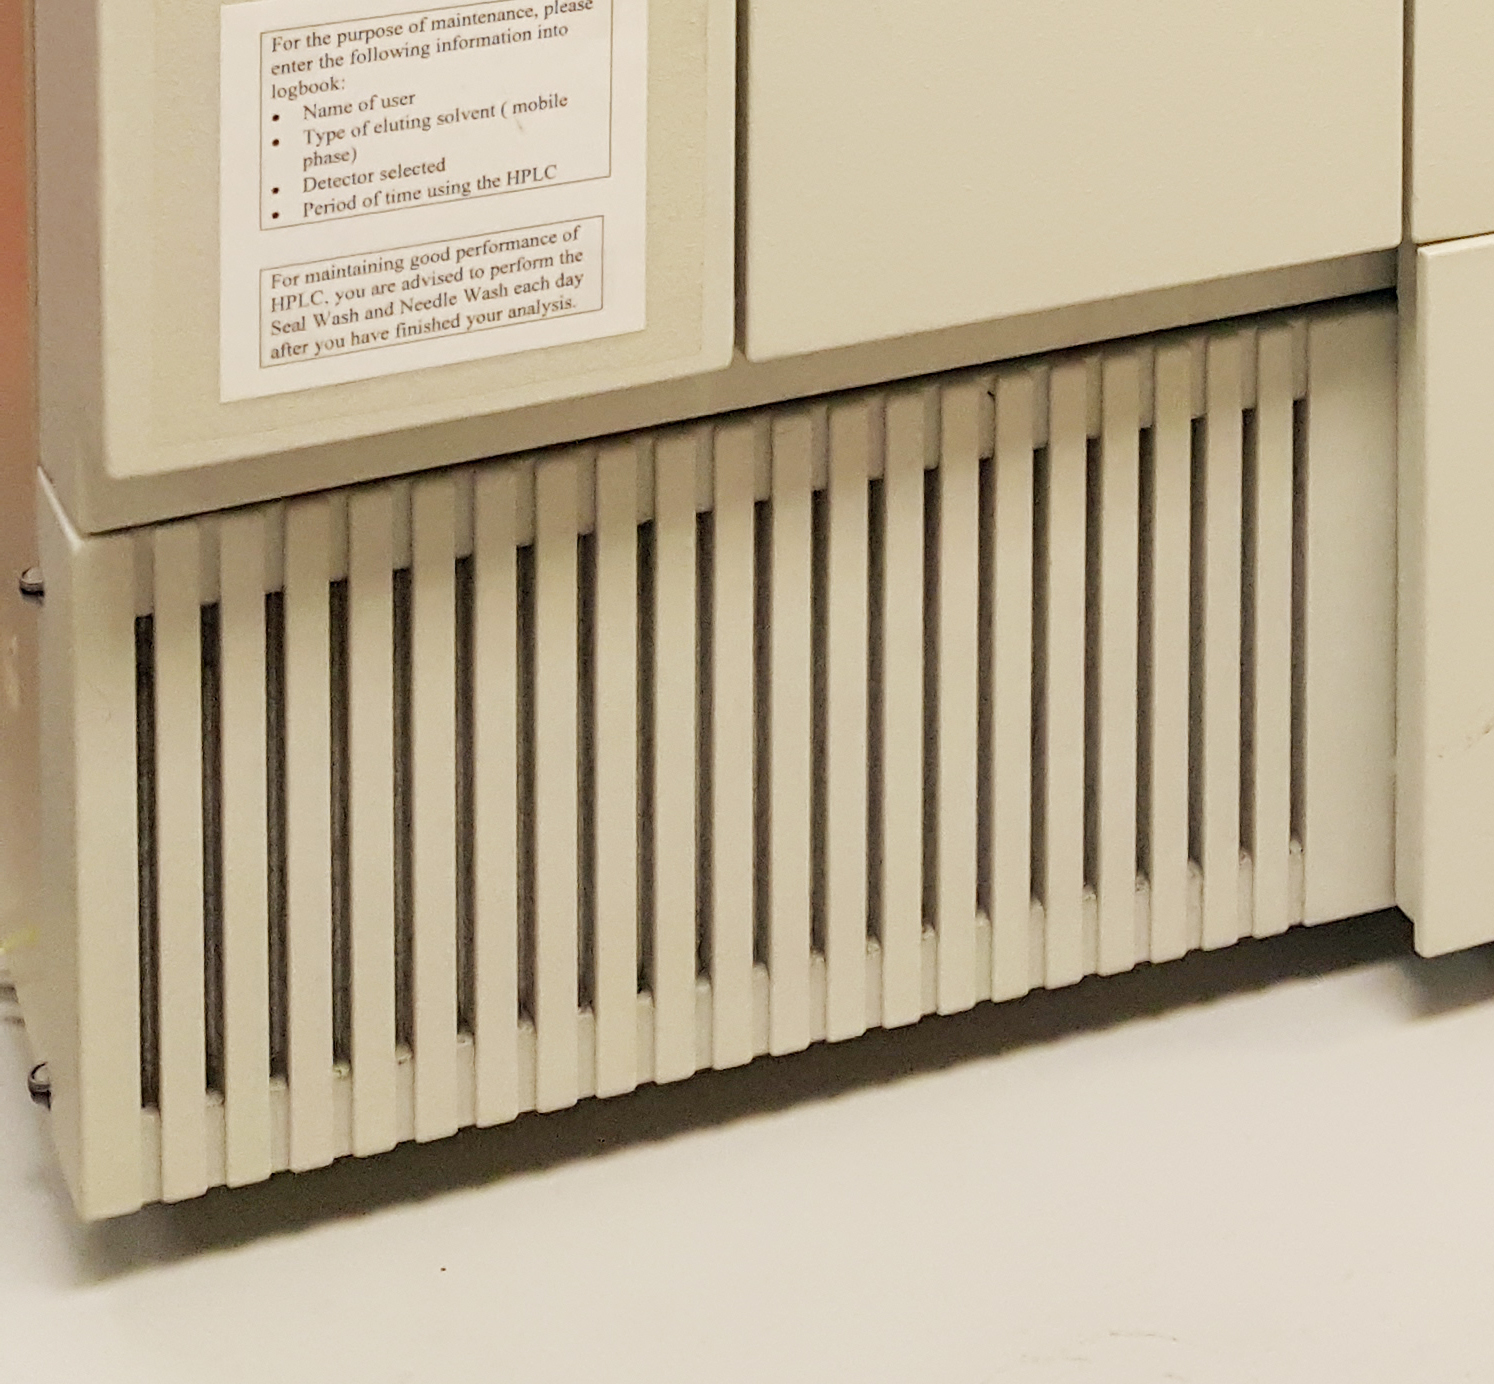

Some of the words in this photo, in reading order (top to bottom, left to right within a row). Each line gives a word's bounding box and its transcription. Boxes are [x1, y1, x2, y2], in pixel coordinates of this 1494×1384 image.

[271, 35, 301, 53] For
[306, 31, 331, 48] the
[336, 24, 404, 48] purpose
[408, 16, 428, 33] of
[431, 5, 539, 31] maintenance,
[271, 58, 314, 75] enter
[319, 53, 344, 69] the
[350, 41, 431, 66] following
[436, 28, 533, 54] information
[537, 24, 569, 40] into
[271, 76, 346, 101] logbook:
[303, 101, 353, 120] Name
[358, 94, 378, 111] of
[381, 93, 416, 108] user
[303, 127, 346, 148] Type
[350, 120, 370, 138] of
[373, 114, 432, 134] eluting
[436, 105, 496, 126] solvent
[512, 93, 569, 115] mobile
[303, 148, 358, 172] phase)
[303, 170, 374, 194] Detector
[379, 157, 446, 181] selected
[303, 194, 357, 218] Period
[362, 190, 382, 209] of
[385, 187, 422, 205] time
[427, 179, 472, 199] using
[477, 175, 501, 191] the
[506, 164, 557, 186] HPLC
[271, 273, 299, 290] For
[305, 256, 405, 285] maintaining
[410, 246, 451, 271] good
[456, 231, 558, 264] performance
[562, 225, 581, 242] of
[335, 287, 366, 308] you
[371, 281, 396, 297] are
[401, 266, 464, 292] advised
[469, 265, 485, 281] to
[490, 255, 554, 281] perform
[559, 249, 584, 265] the
[270, 341, 309, 360] after
[313, 336, 346, 357] you
[350, 328, 390, 347] have
[395, 312, 461, 339] finished
[466, 309, 504, 331] your
[508, 294, 577, 318] analysis.
[271, 315, 306, 337] Seal
[313, 308, 360, 328] Wash
[364, 301, 395, 321] and
[400, 292, 458, 315] Needle
[464, 283, 509, 303] Wash
[513, 276, 550, 296] each
[555, 272, 585, 290] day
